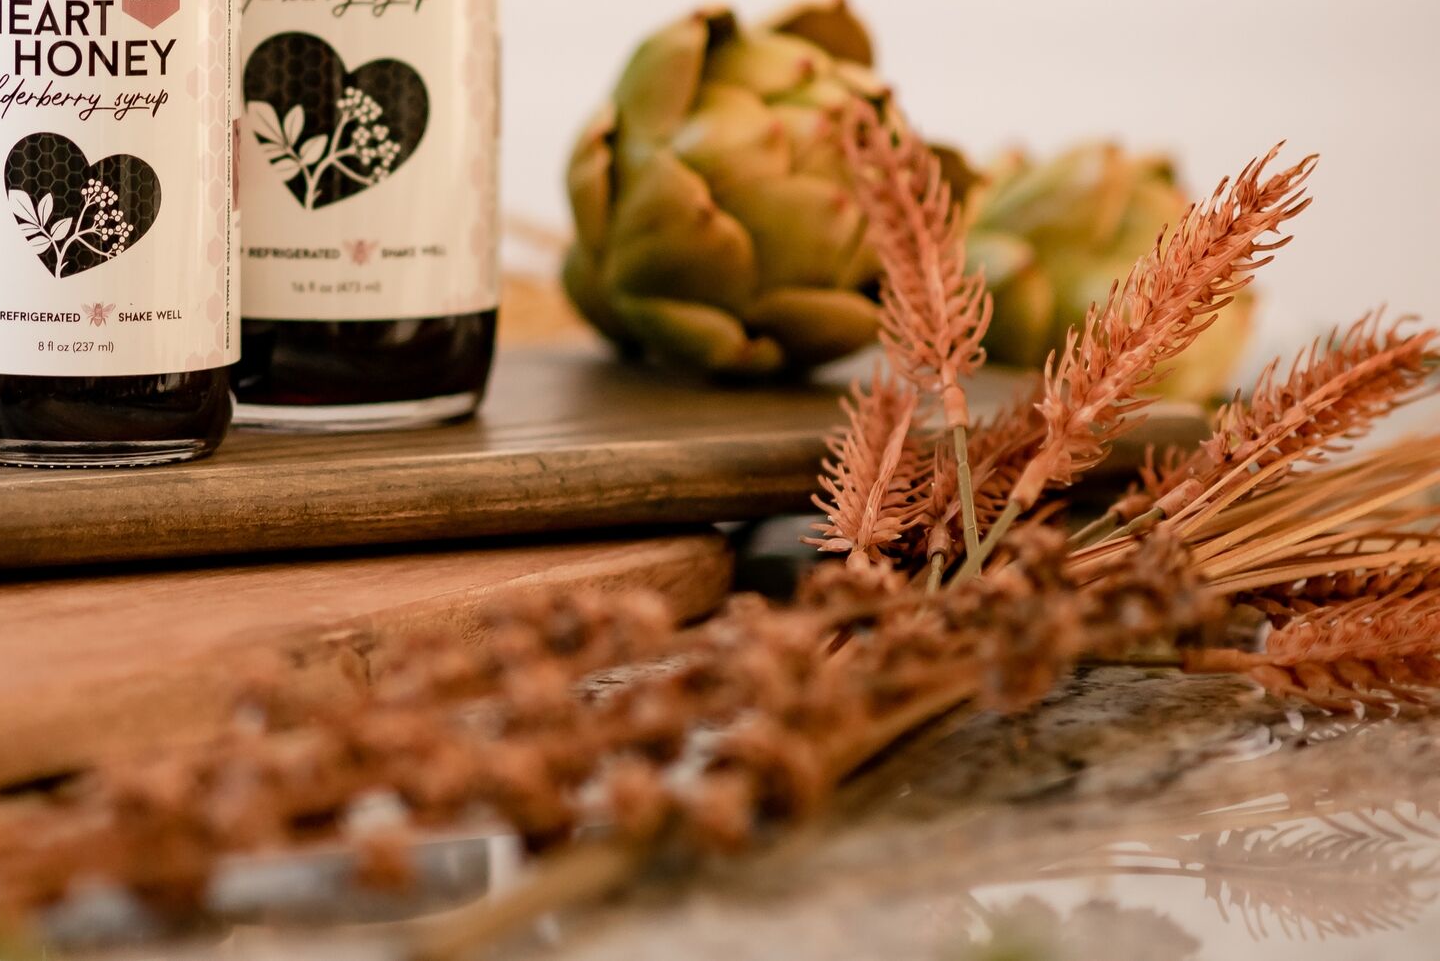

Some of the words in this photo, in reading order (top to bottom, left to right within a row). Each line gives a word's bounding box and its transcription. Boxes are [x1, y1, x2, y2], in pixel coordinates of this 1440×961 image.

[14, 39, 177, 77] HONEY
[113, 89, 169, 122] syrup
[248, 247, 341, 260] REFRIGERATED
[0, 310, 81, 323] REFRIGERATED
[118, 311, 153, 323] SHAKE
[156, 309, 182, 320] WELL
[37, 341, 45, 352] 8
[47, 340, 54, 352] fl
[57, 344, 70, 352] oz
[72, 341, 95, 354] (237
[98, 341, 114, 354] ml)
